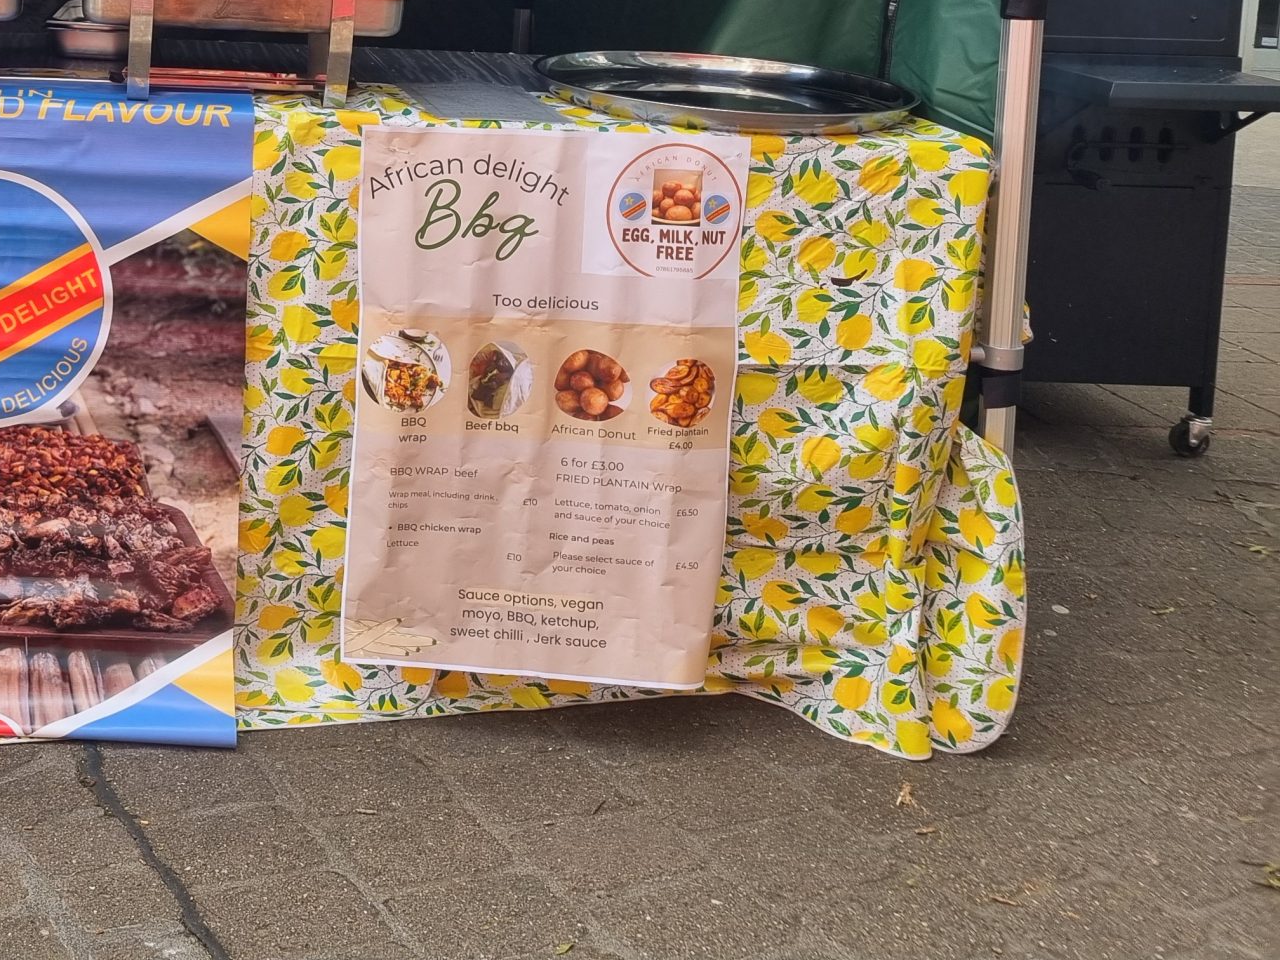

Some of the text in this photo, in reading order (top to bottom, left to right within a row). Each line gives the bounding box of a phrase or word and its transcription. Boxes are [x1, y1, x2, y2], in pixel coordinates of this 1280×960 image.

[37, 98, 233, 128] FLAVOUR
[370, 154, 569, 206] African delight
[622, 228, 726, 246] EGG, MILK, NUT
[656, 245, 694, 260] FREE
[0, 268, 98, 333] DELIGHT
[493, 294, 599, 310] Too delicious
[0, 337, 88, 414] DELICIOUS
[401, 417, 427, 427] BBQ
[465, 421, 519, 433] Beef bbq
[399, 434, 427, 443] wrap
[551, 425, 636, 440] African Donut
[647, 427, 709, 438] Fried plantain
[669, 442, 693, 450] £4.00
[561, 458, 624, 472] 6 for £3.00
[390, 467, 478, 478] BBQ WRAP beef
[556, 474, 682, 494] FRIED PLANTAIN Wrap
[433, 491, 470, 501] including
[633, 506, 661, 515] onion
[554, 511, 572, 520] and
[574, 514, 602, 523] sauce
[615, 517, 636, 525] your
[639, 519, 670, 529] choice
[420, 524, 455, 532] chicken
[387, 540, 419, 548] Lettuce
[549, 533, 568, 541] Rice
[592, 538, 615, 546] peas
[507, 553, 521, 562] £10
[553, 551, 583, 561] Please
[586, 555, 613, 564] select
[616, 558, 642, 566] sauce
[552, 564, 606, 575] your choice
[458, 589, 604, 612] Sauce options, vegan
[463, 608, 599, 631] moyo, BBQ, ketchup,
[450, 627, 607, 649] sweet chilli Jerk sauce
